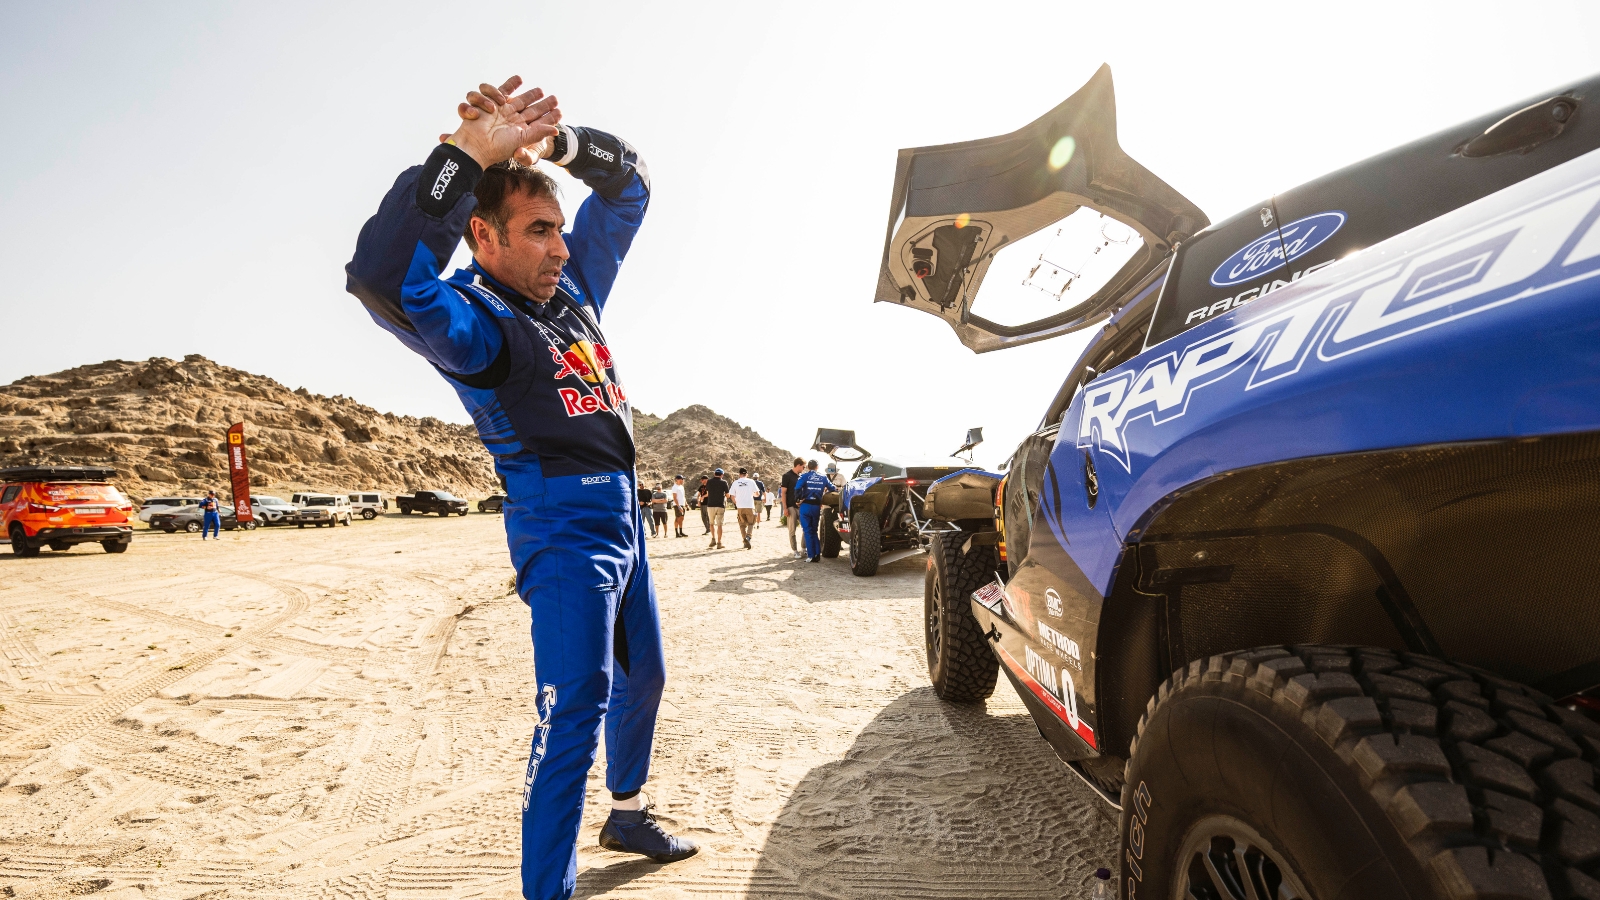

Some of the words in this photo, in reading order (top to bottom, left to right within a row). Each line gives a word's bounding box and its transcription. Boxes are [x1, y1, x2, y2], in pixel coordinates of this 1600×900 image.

[587, 143, 615, 163] sparc
[431, 159, 459, 200] sparco
[1229, 225, 1318, 280] Ford
[1077, 178, 1600, 474] RAPTO
[233, 446, 243, 470] PARKING
[581, 475, 611, 486] sparco
[1037, 620, 1081, 661] METHOD
[1040, 638, 1054, 653] RACE
[1055, 647, 1082, 671] WHEELS
[1025, 644, 1060, 698] OPTIMA
